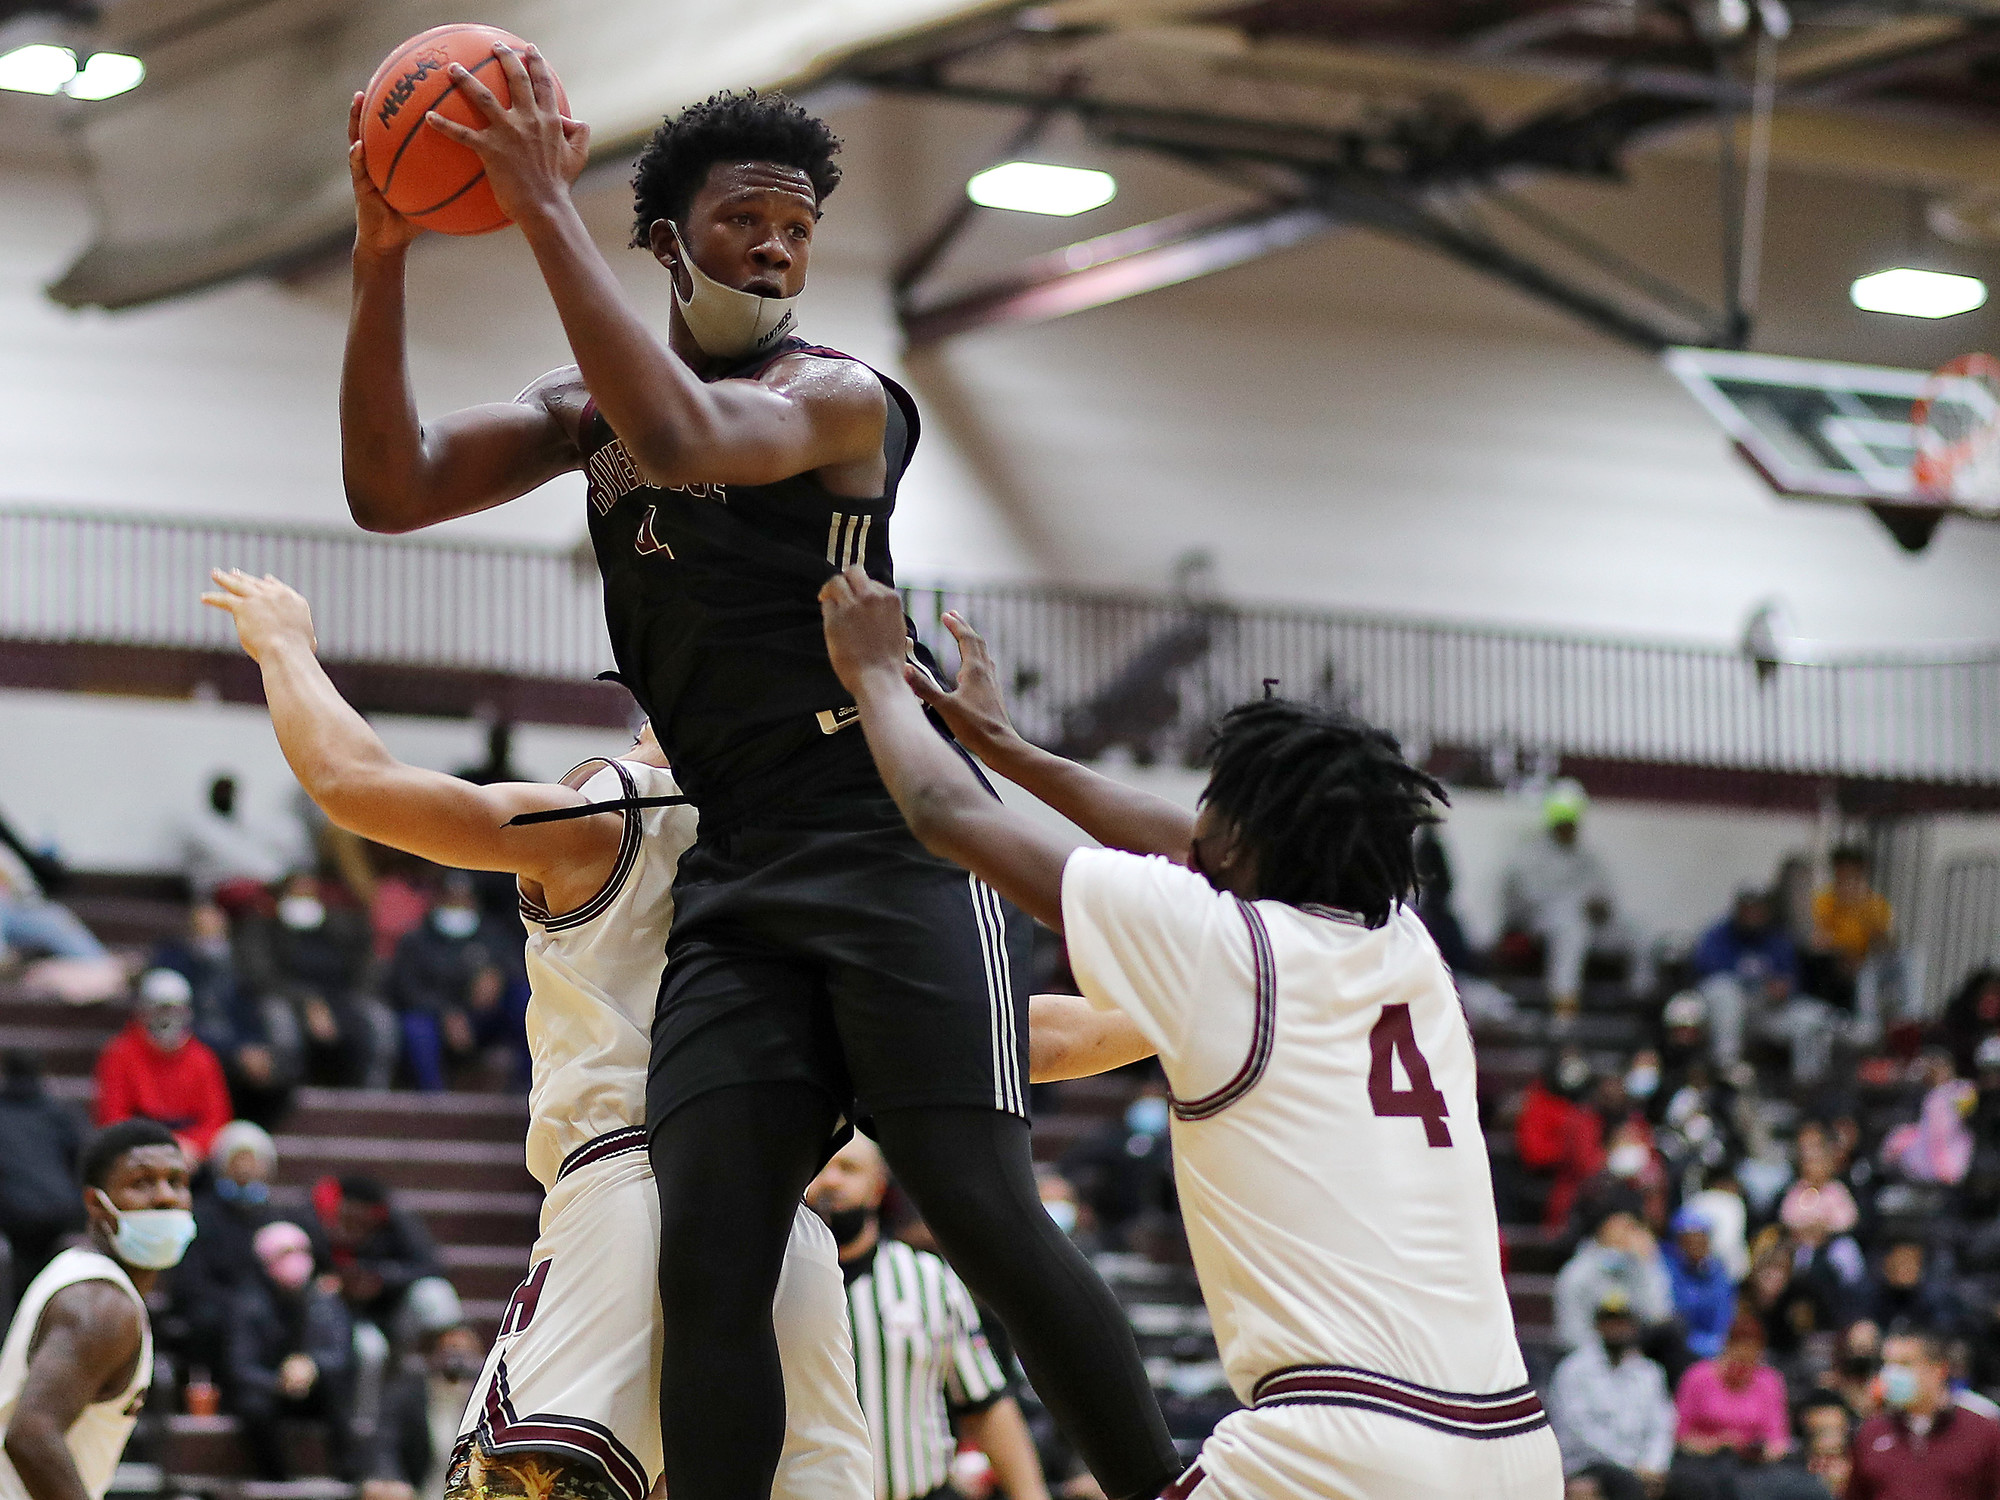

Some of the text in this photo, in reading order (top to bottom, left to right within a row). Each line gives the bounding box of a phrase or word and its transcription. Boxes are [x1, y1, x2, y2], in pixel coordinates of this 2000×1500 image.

[378, 59, 441, 130] MHSAA
[634, 504, 676, 560] 4
[1368, 1003, 1453, 1147] 4
[498, 1255, 554, 1339] H
